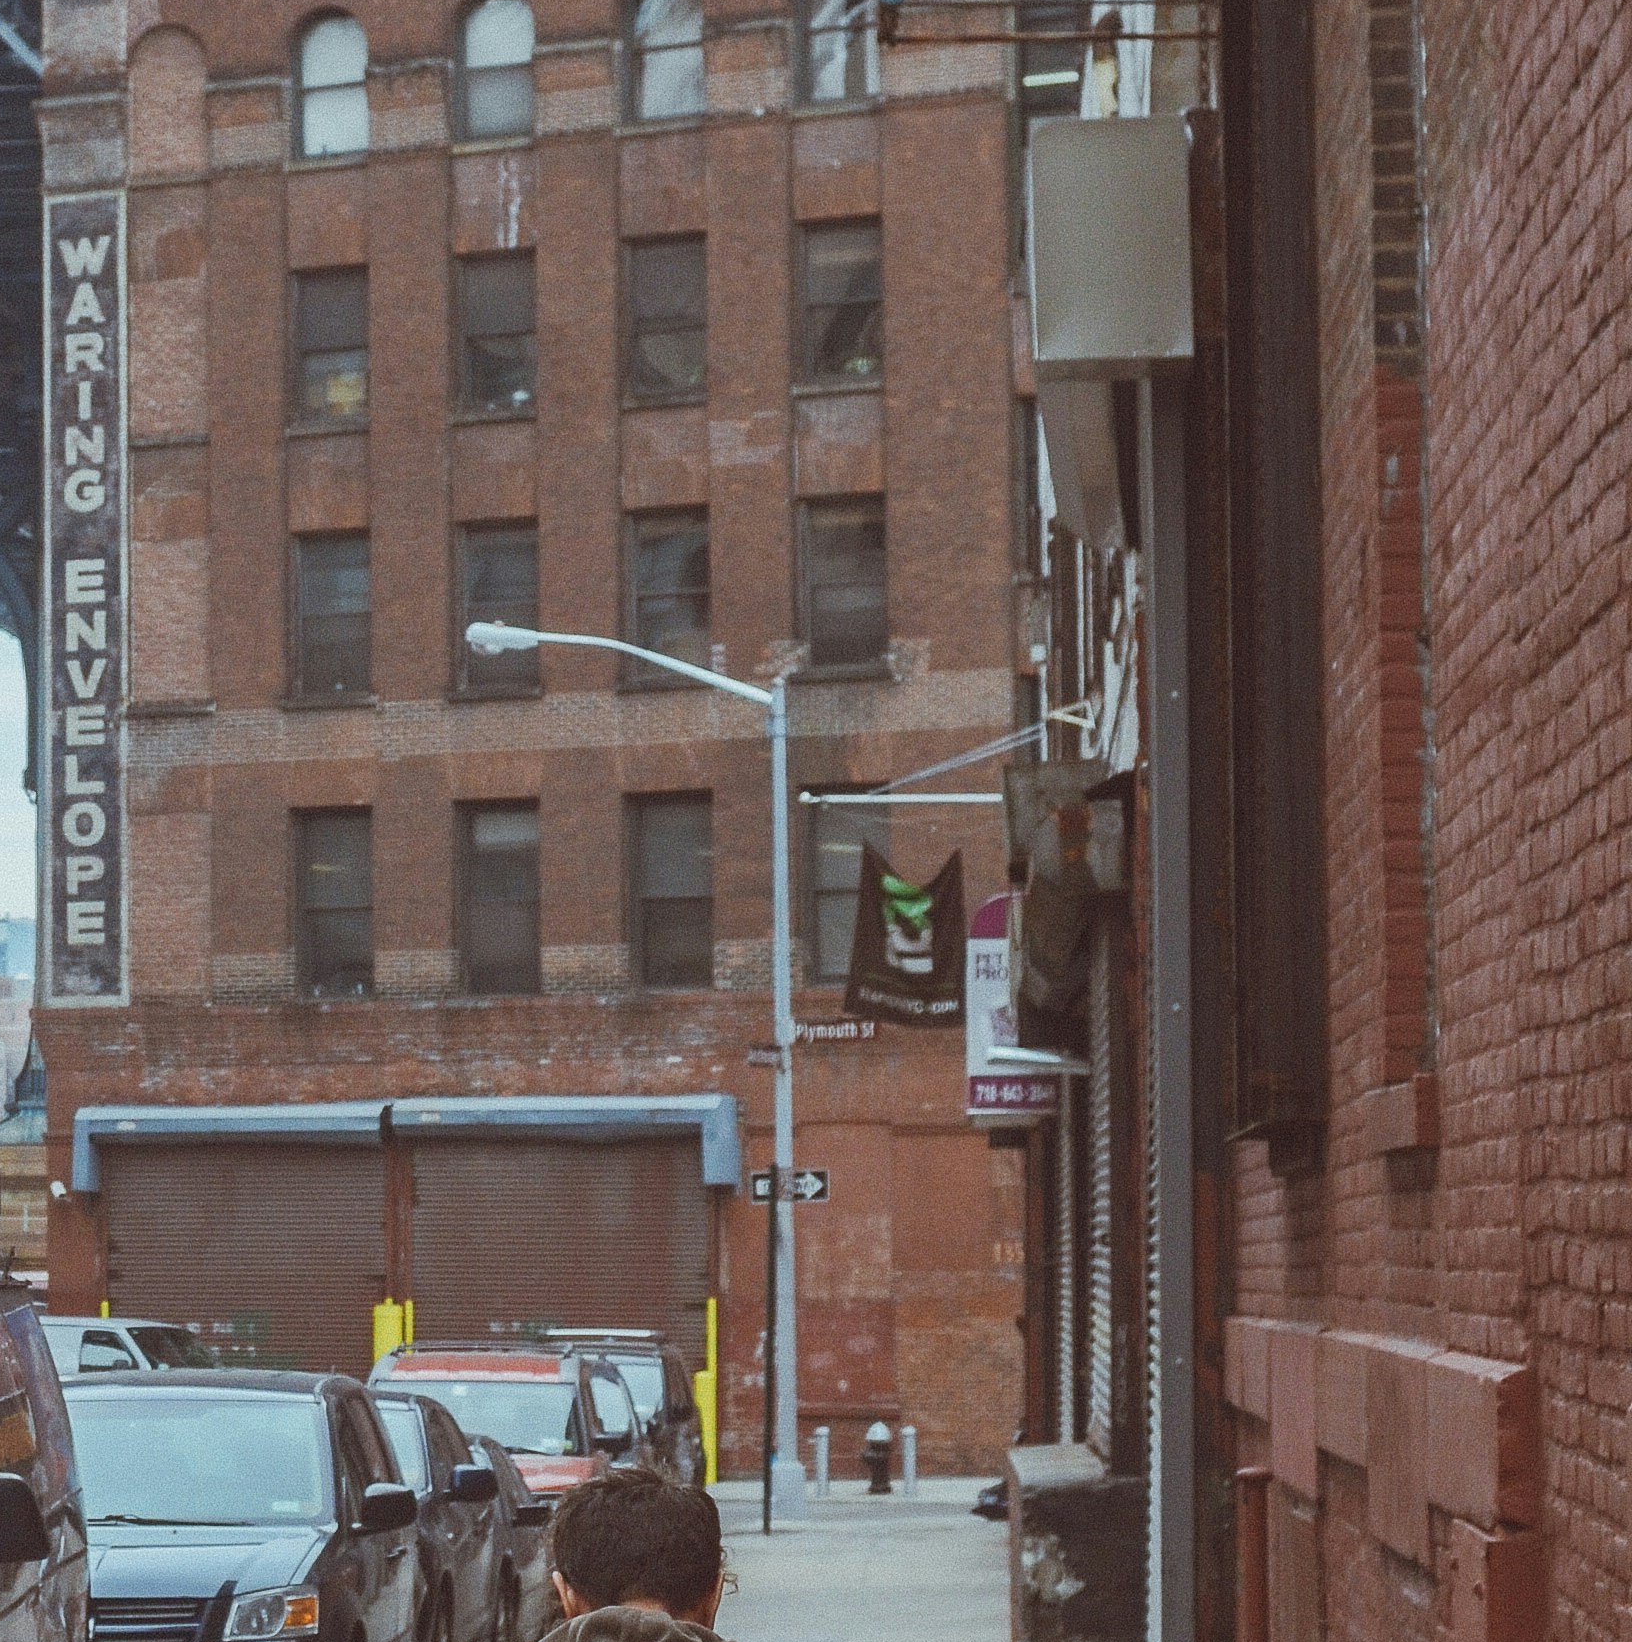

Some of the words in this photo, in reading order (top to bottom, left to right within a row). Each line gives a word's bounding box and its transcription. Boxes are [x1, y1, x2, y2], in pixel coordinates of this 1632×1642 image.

[57, 235, 111, 513] WARING
[62, 558, 107, 946] ENVELOPE
[796, 1022, 858, 1043] Plymouth
[860, 1022, 875, 1038] St
